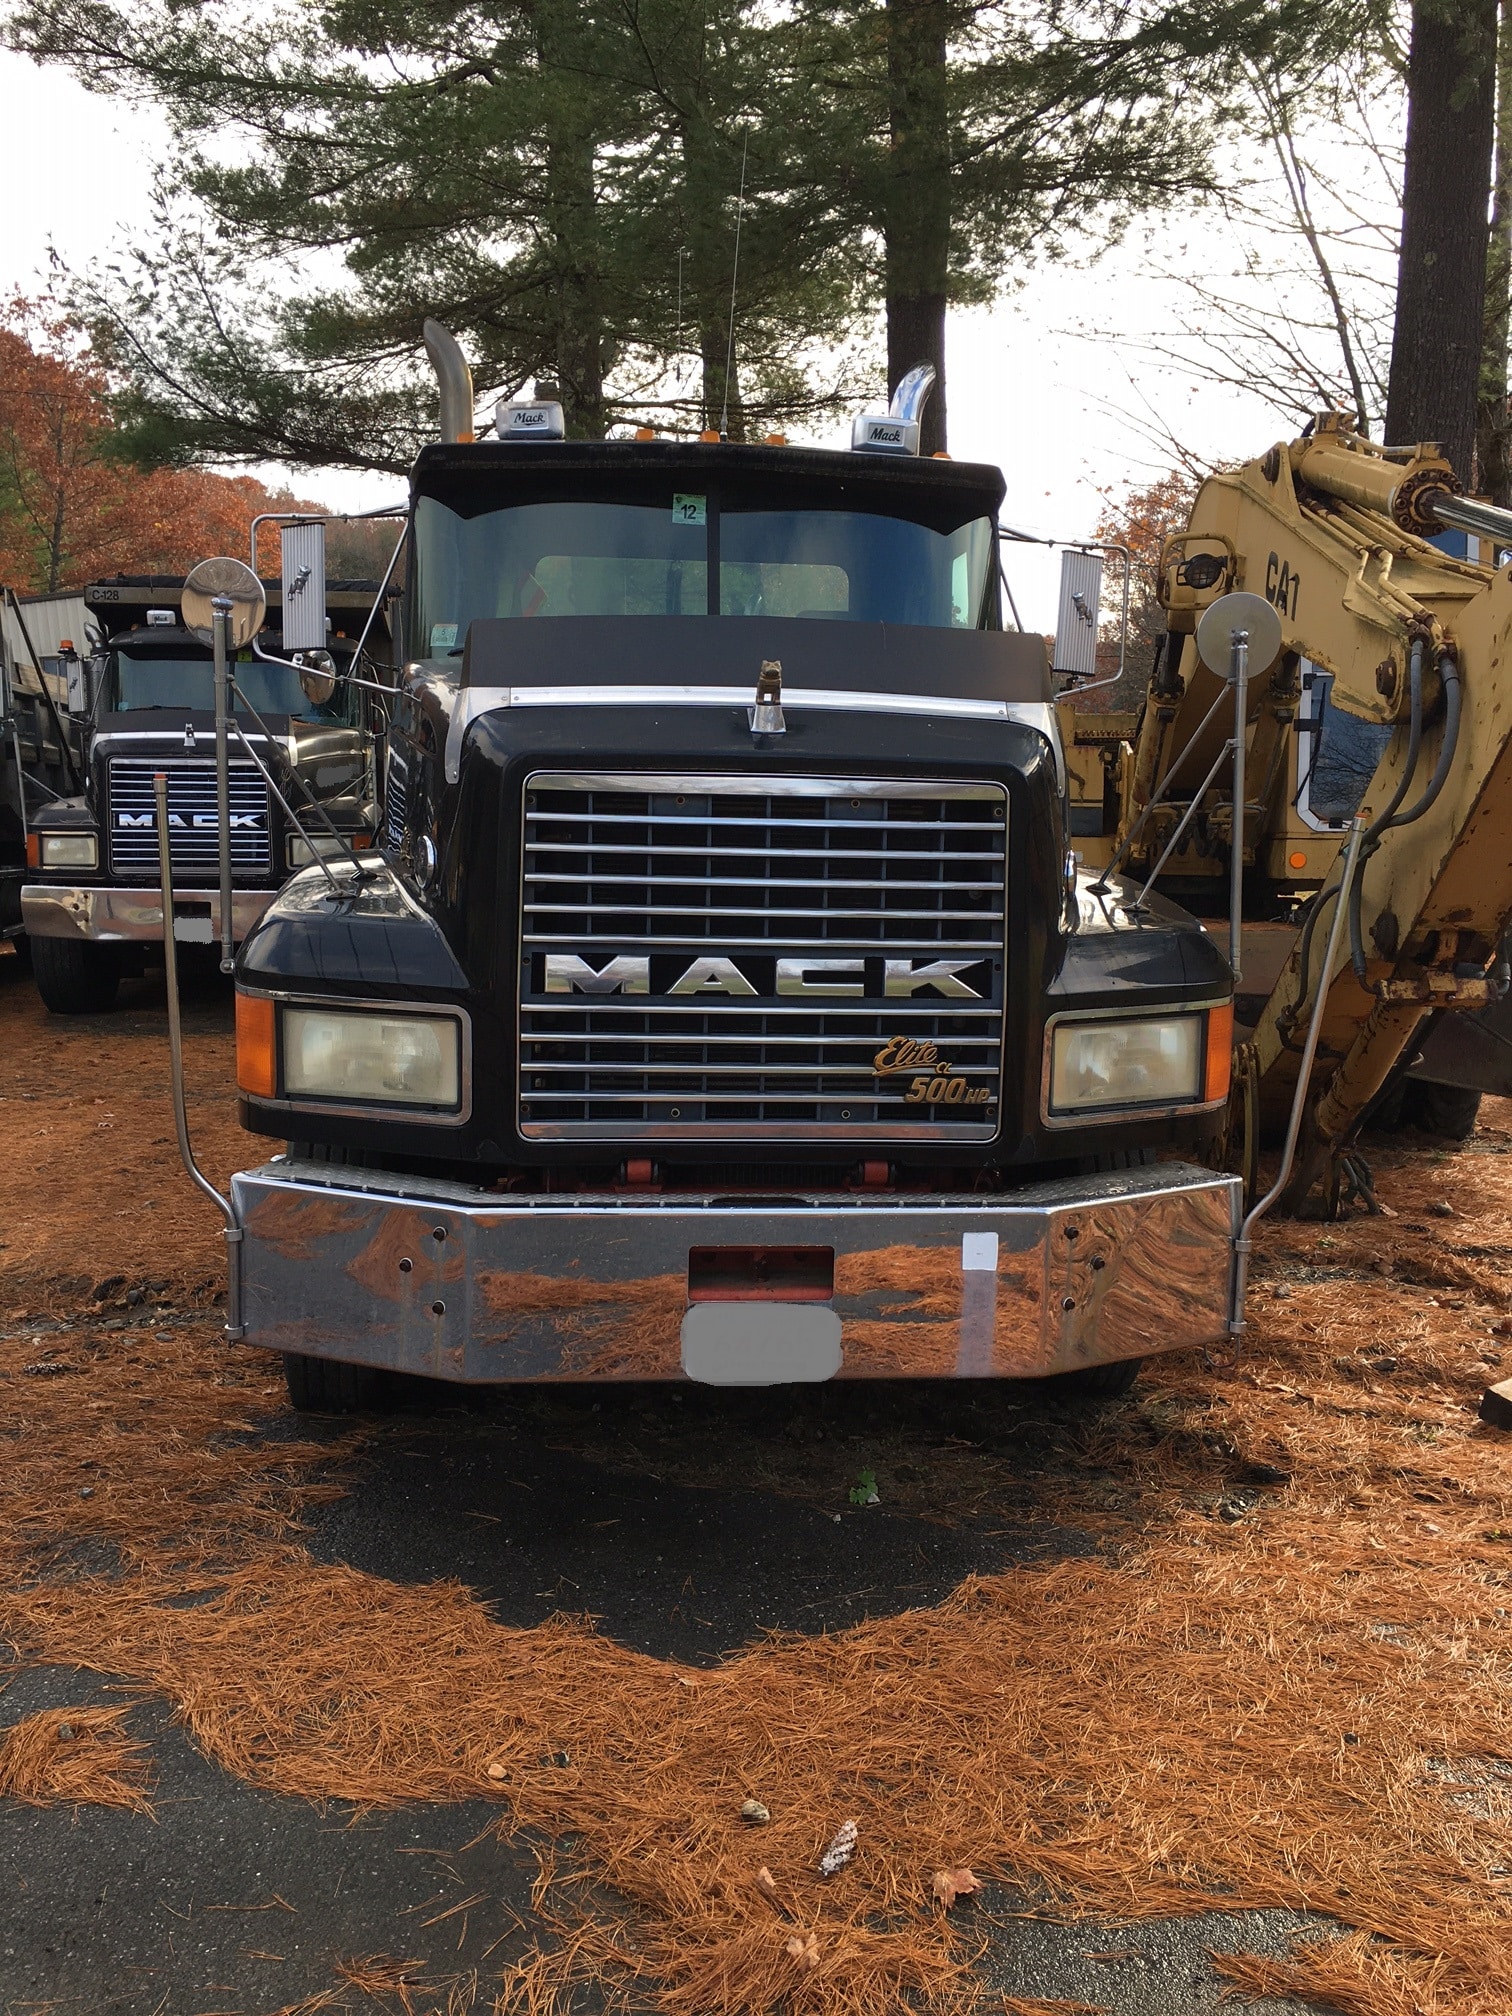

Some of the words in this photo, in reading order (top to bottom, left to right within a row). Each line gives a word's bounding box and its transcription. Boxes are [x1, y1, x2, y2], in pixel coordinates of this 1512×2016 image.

[513, 412, 546, 426] Mack
[870, 427, 901, 442] Mack
[680, 504, 697, 520] 12
[92, 589, 120, 601] C-128
[544, 953, 986, 998] MACK
[872, 1035, 938, 1077] Elite
